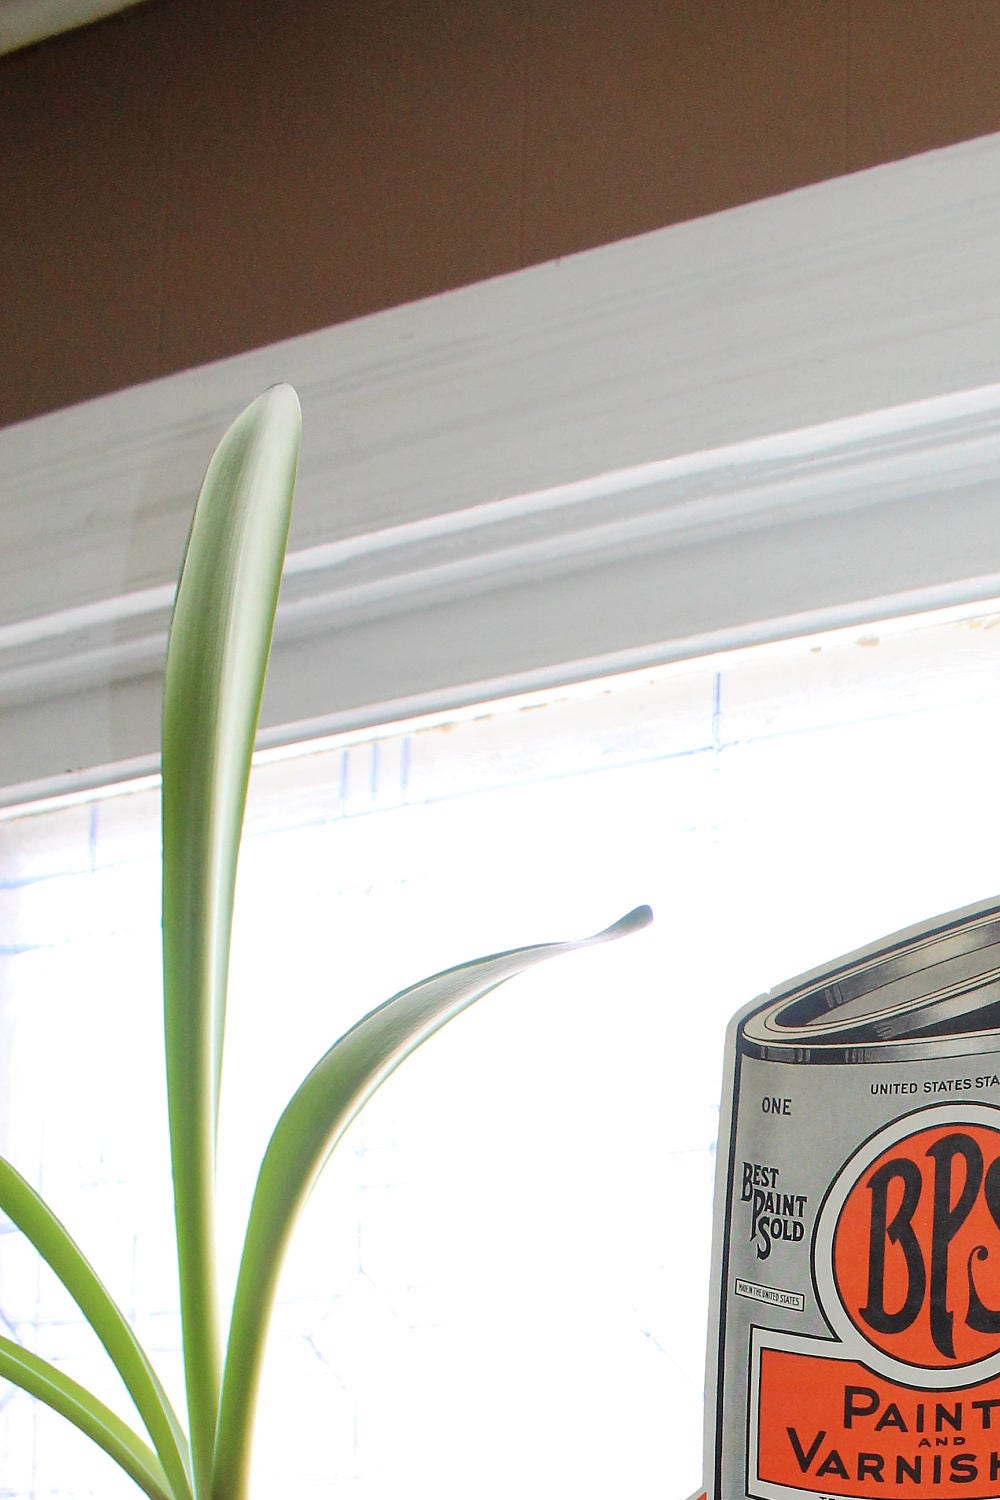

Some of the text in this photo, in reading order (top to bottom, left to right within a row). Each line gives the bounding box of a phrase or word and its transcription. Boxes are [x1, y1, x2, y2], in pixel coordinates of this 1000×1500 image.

[870, 1082, 918, 1095] UNITED
[923, 1079, 972, 1093] STATES
[761, 1096, 792, 1116] ONE
[740, 1161, 780, 1202] BEST
[750, 1188, 808, 1242] PAINT
[756, 1215, 805, 1261] SOLD
[780, 1294, 800, 1306] STATES
[918, 1436, 966, 1448] AND
